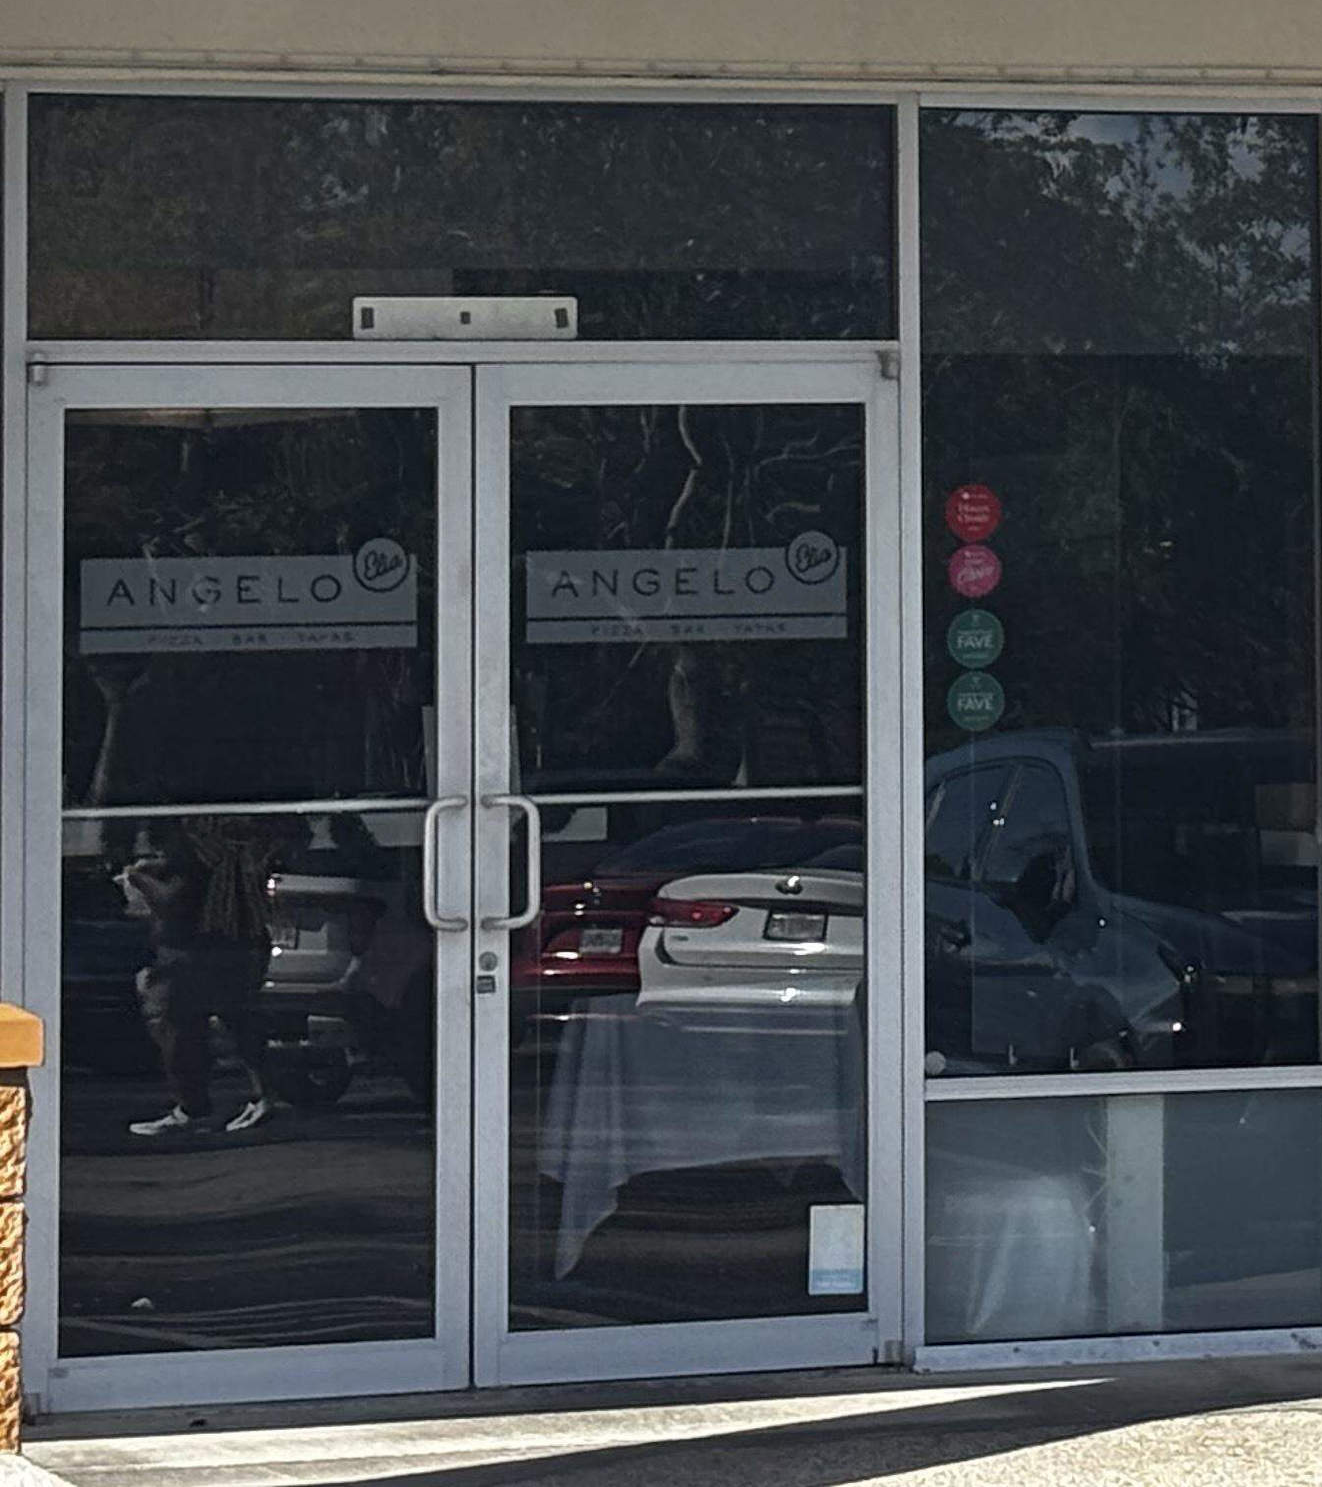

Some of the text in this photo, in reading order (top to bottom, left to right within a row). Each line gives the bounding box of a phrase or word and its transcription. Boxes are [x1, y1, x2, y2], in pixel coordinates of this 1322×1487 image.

[107, 574, 341, 607] ANGELO
[551, 567, 775, 598] ANGELO
[957, 634, 994, 649] FAVE
[957, 697, 994, 712] FAVE
